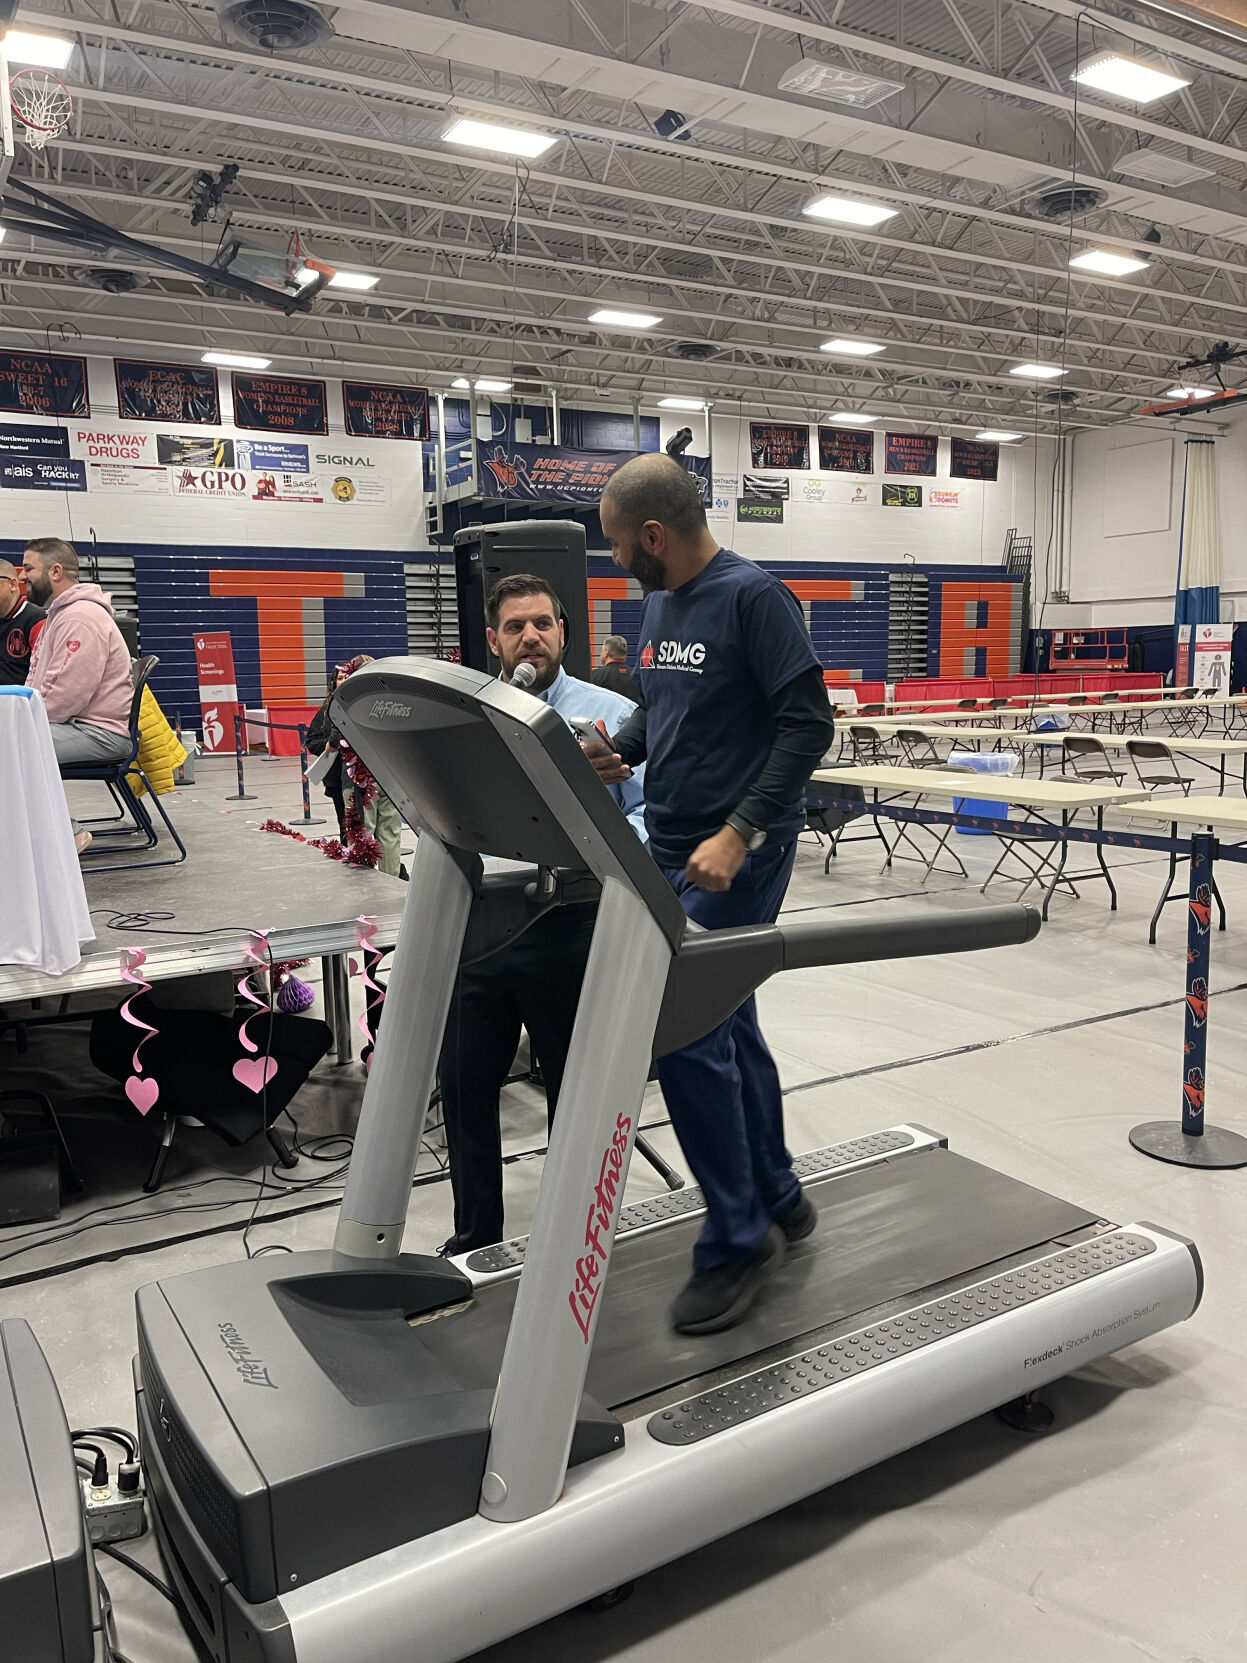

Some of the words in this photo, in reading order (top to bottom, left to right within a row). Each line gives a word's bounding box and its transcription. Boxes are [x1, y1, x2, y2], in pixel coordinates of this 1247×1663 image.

[10, 359, 52, 373] NCAA
[0, 371, 45, 385] SWEET
[54, 376, 68, 387] 16
[251, 381, 299, 395] EMPIRE
[301, 387, 308, 395] 8
[19, 395, 50, 407] 2006
[240, 391, 274, 401] WOMEN'S
[275, 395, 321, 406] BASKETBALL
[370, 390, 403, 402] NCAA
[253, 403, 308, 414] CHAMPIONS
[268, 415, 294, 425] 2008
[0, 435, 40, 443] Northwestern
[77, 432, 147, 446] PARKWAY
[892, 437, 925, 447] EMPIRE
[89, 446, 140, 459] DRUGS
[254, 443, 262, 451] Be
[315, 454, 376, 467] SIGNAL
[533, 458, 588, 471] HOME
[591, 462, 617, 473] OF
[14, 464, 33, 477] ais
[41, 471, 69, 479] HACK
[201, 470, 246, 491] GPO
[530, 470, 566, 482] THE
[569, 473, 609, 485] PION
[803, 486, 826, 496] Cooley
[658, 640, 706, 665] SDMG
[1066, 1333, 1090, 1351] Shock
[1091, 1315, 1132, 1339] Absorption
